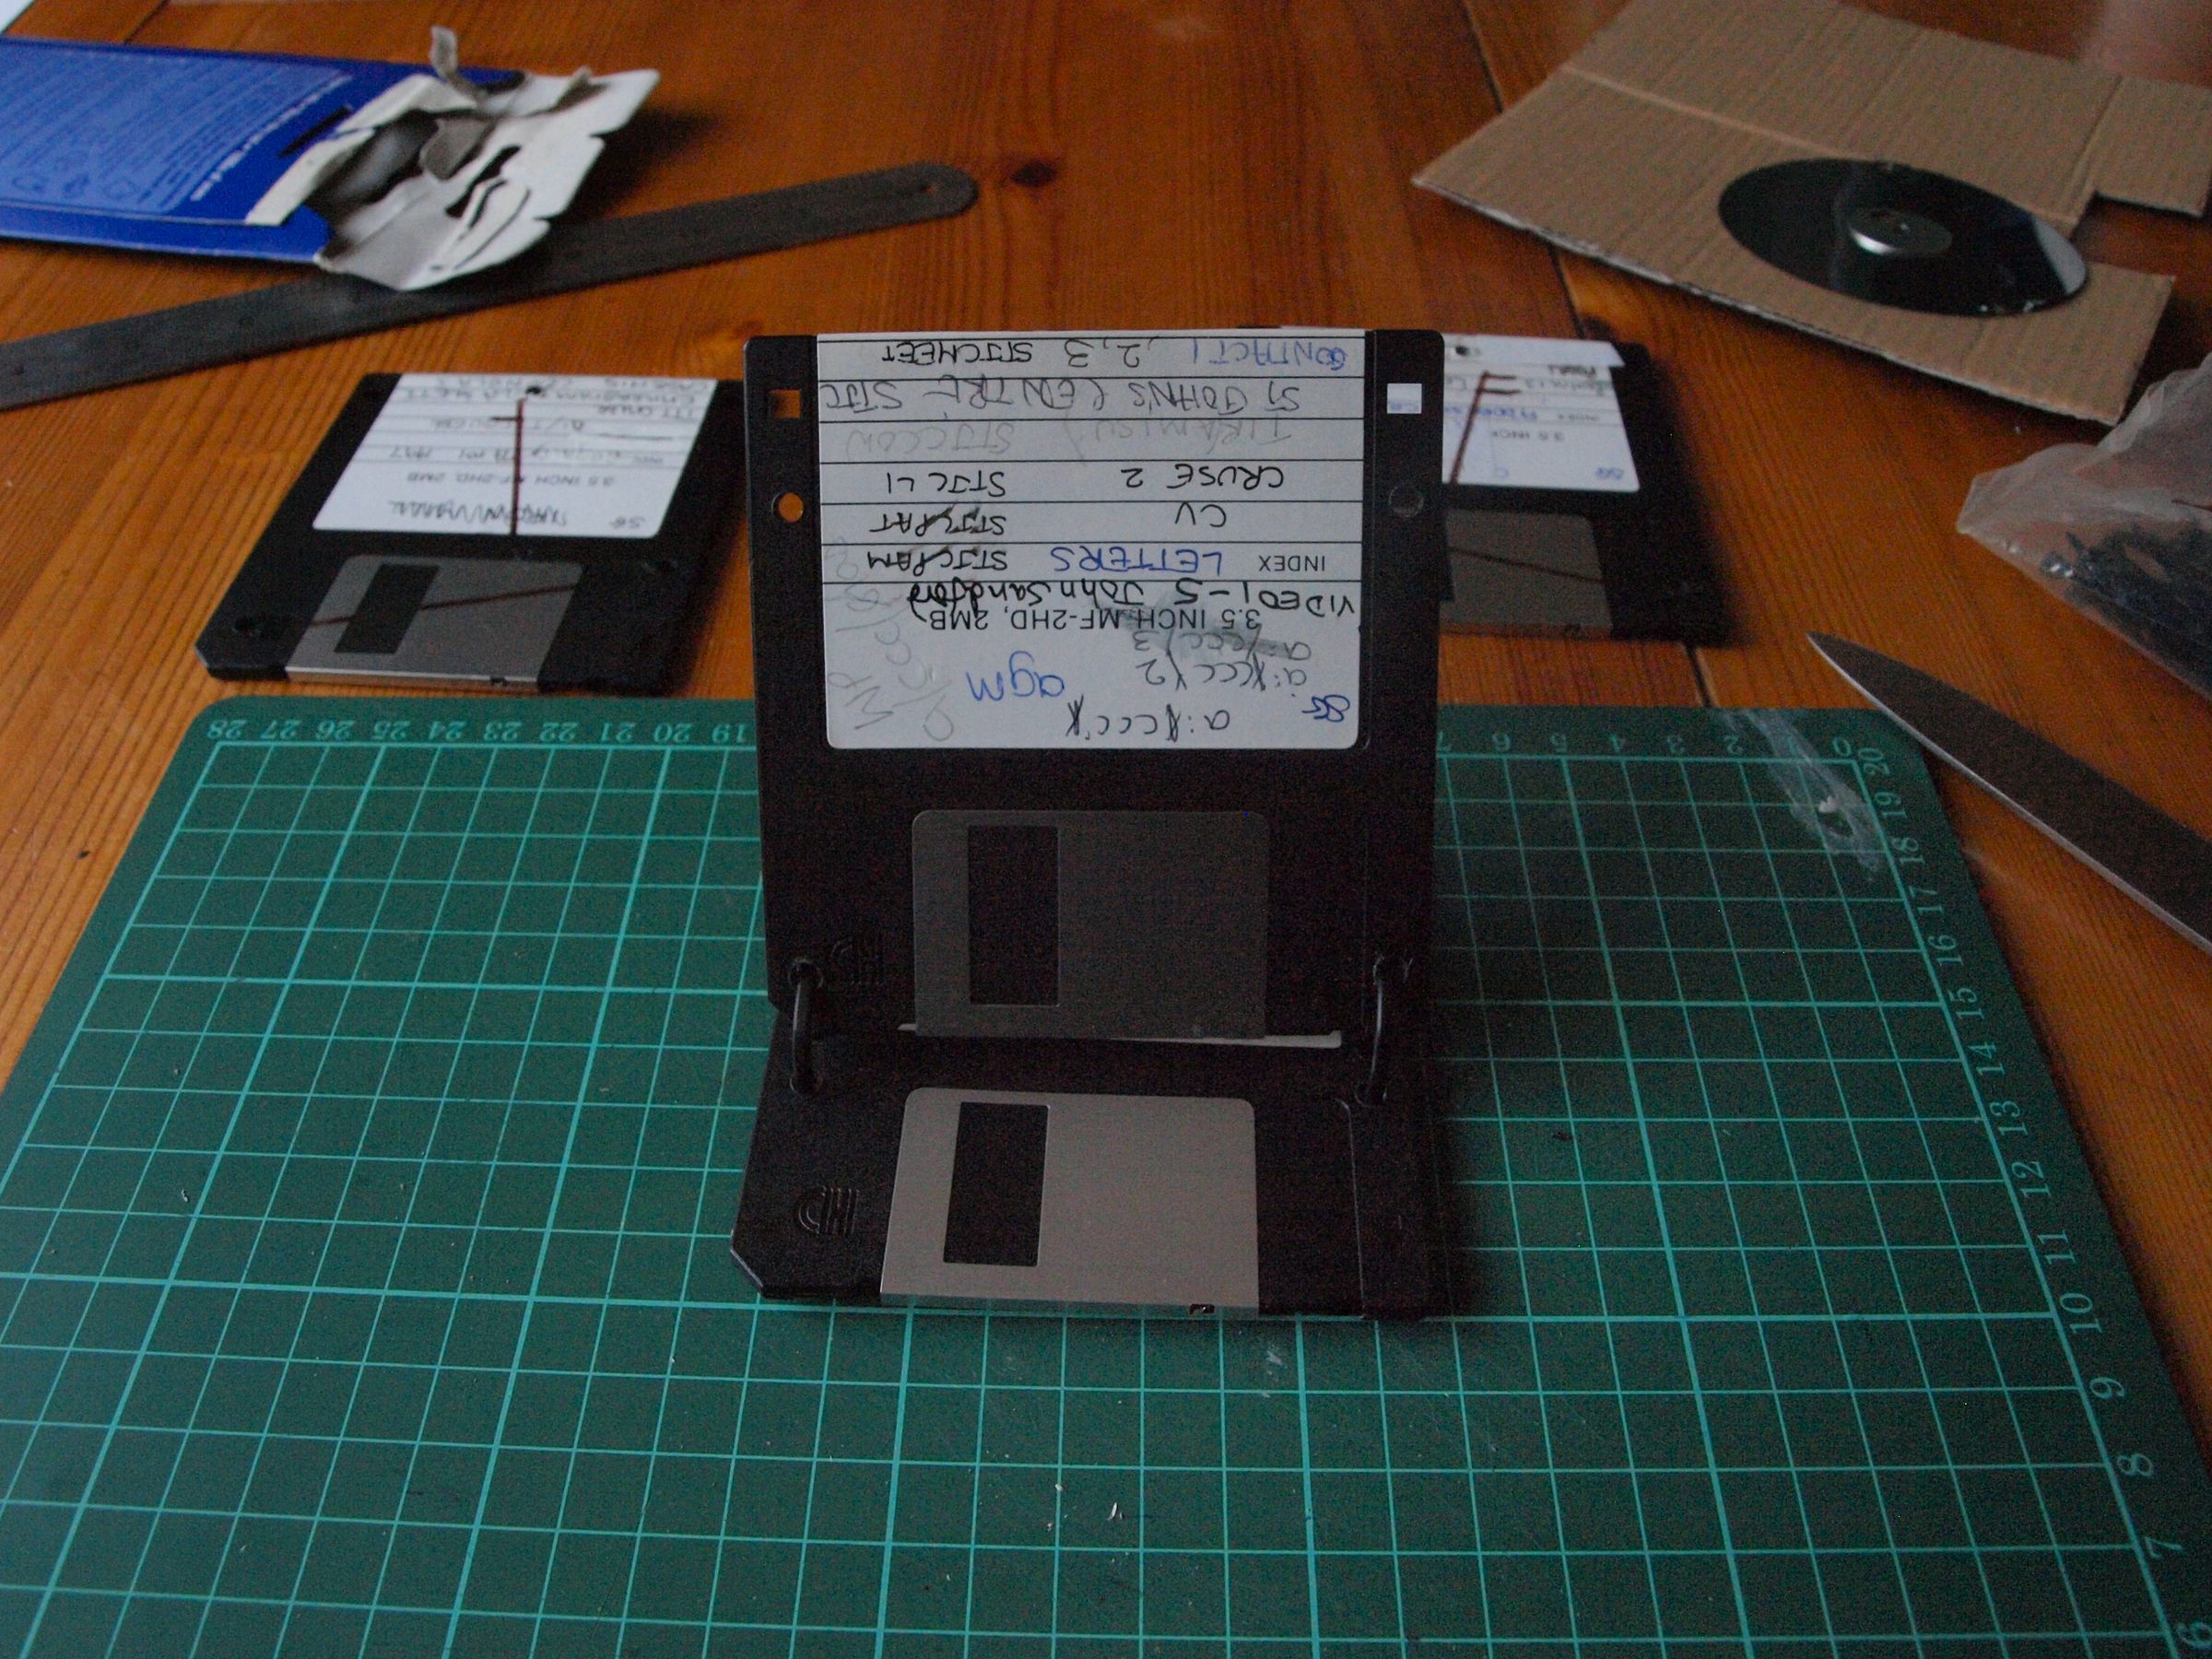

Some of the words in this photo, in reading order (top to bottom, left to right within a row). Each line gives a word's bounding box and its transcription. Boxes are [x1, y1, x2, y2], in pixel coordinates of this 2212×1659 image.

[1120, 467, 1144, 488] 2
[1166, 463, 1284, 491] CRUSE
[1174, 500, 1227, 528] CV
[1050, 546, 1223, 576] LETTERS
[1257, 555, 1326, 572] INDEX
[1060, 578, 1144, 610] John
[1258, 589, 1355, 618] VIDEO
[1136, 608, 1206, 629] INCH
[1220, 608, 1260, 629] 3.5
[965, 650, 1065, 701] agm
[206, 719, 247, 739] 28
[260, 719, 302, 740] 27
[314, 720, 356, 741] 26
[371, 720, 412, 741] 25
[428, 721, 466, 742] 24
[482, 721, 522, 742] 23
[538, 722, 579, 743] 22
[599, 722, 636, 743] 21
[653, 723, 691, 744] 20
[711, 723, 747, 744] 19
[1857, 747, 1891, 776] 20
[1874, 791, 1909, 819] 19
[1891, 836, 1926, 865] 18
[1908, 884, 1945, 916] 17
[1927, 934, 1965, 967] 16
[1947, 987, 1985, 1020] 15
[1967, 1041, 2007, 1077] 14
[1989, 1100, 2029, 1136] 13
[2011, 1160, 2053, 1198] 12
[2036, 1229, 2079, 1265] 11
[2059, 1292, 2103, 1335] 10
[2088, 1376, 2126, 1400] 9
[2117, 1453, 2155, 1477] 8
[2144, 1535, 2183, 1561] 7
